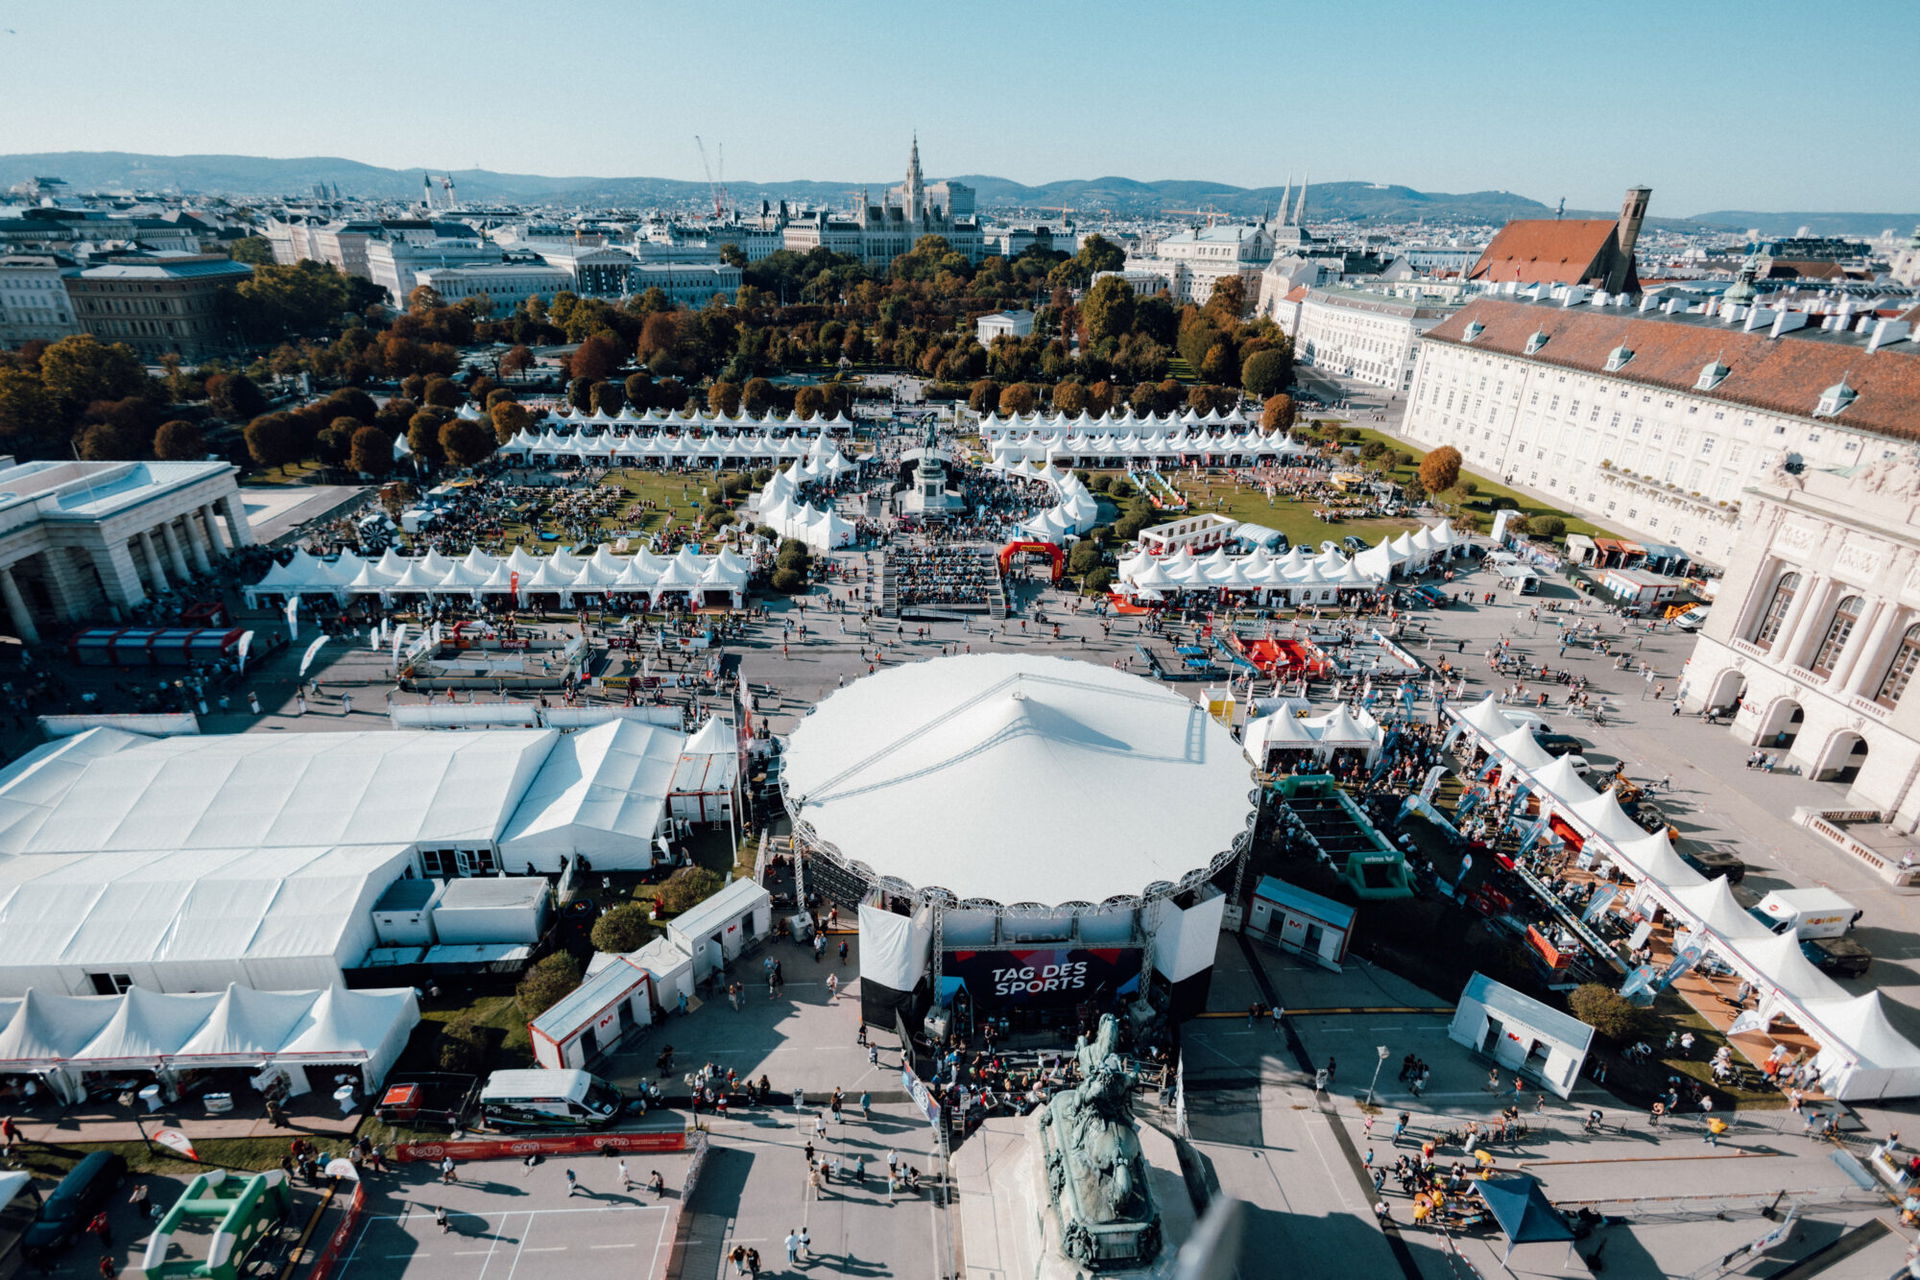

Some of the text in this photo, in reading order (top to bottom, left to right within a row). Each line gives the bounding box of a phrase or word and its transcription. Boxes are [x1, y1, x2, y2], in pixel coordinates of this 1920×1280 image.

[992, 961, 1088, 982] TAG DES
[995, 975, 1086, 996] SPORTS
